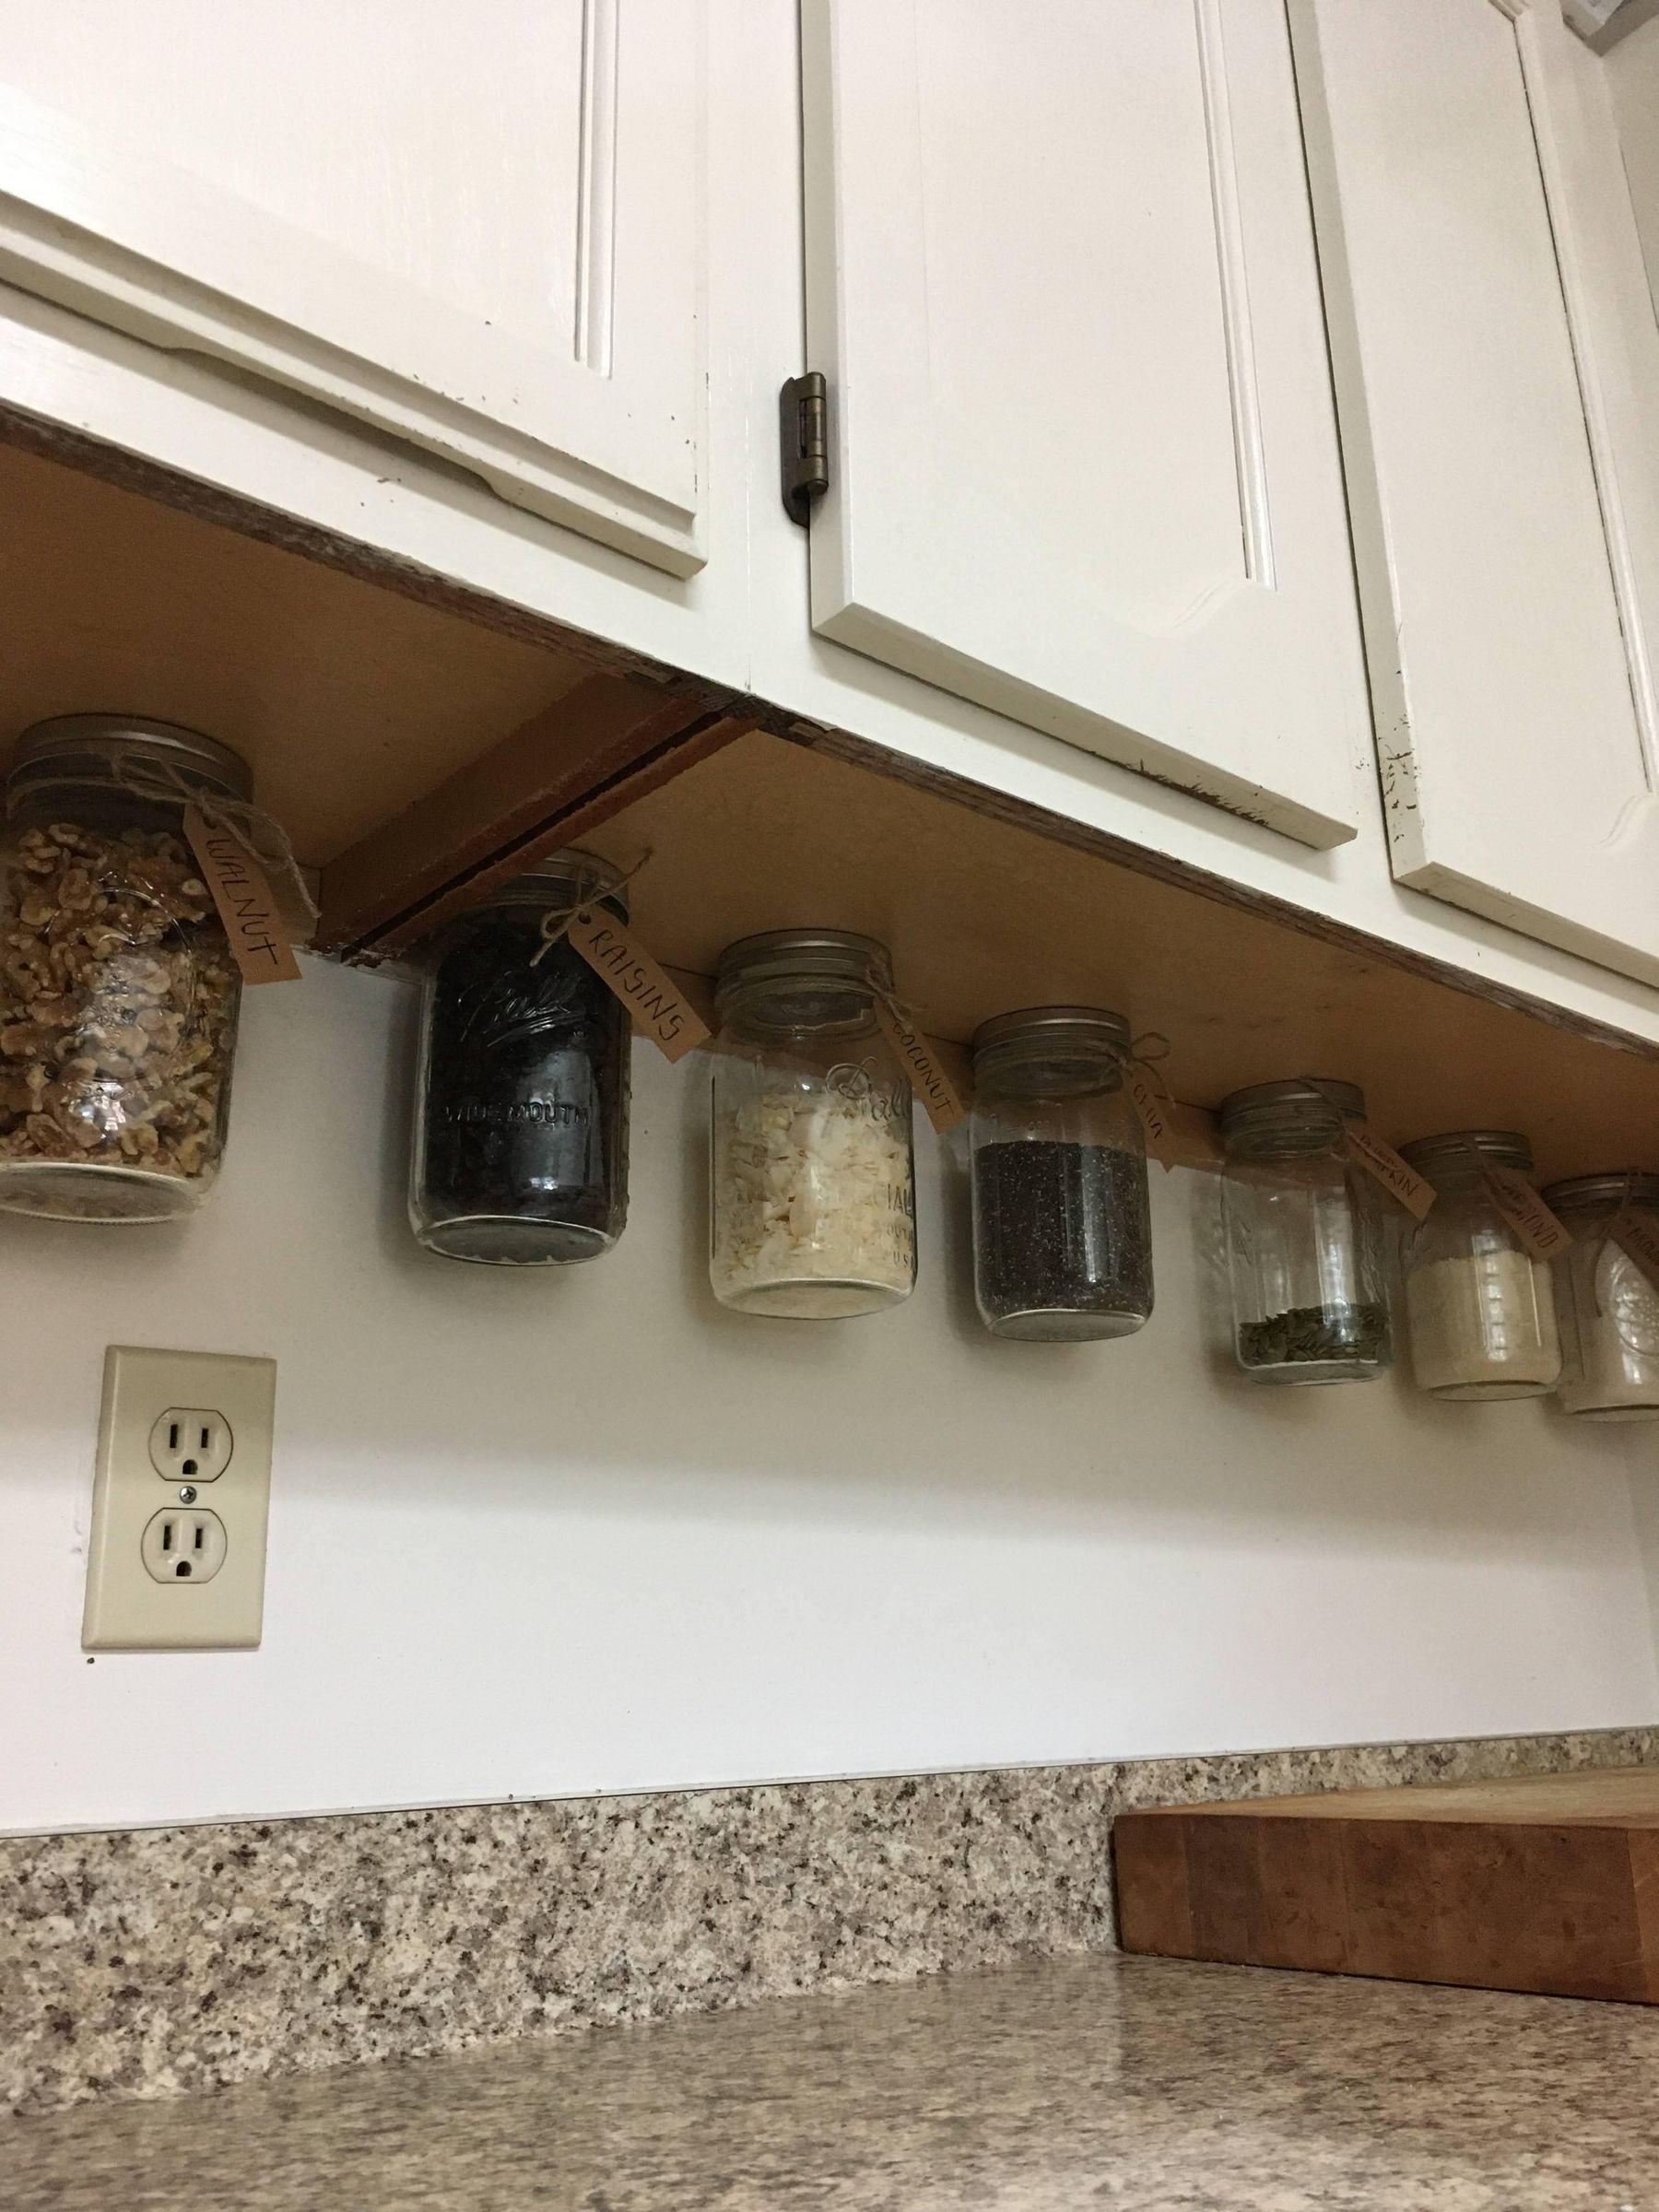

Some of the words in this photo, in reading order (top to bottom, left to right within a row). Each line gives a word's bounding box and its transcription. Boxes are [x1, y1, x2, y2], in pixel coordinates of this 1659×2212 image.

[206, 838, 279, 966] WALNUT
[588, 928, 686, 1041] RAISINS
[892, 1023, 955, 1117] COCONUT
